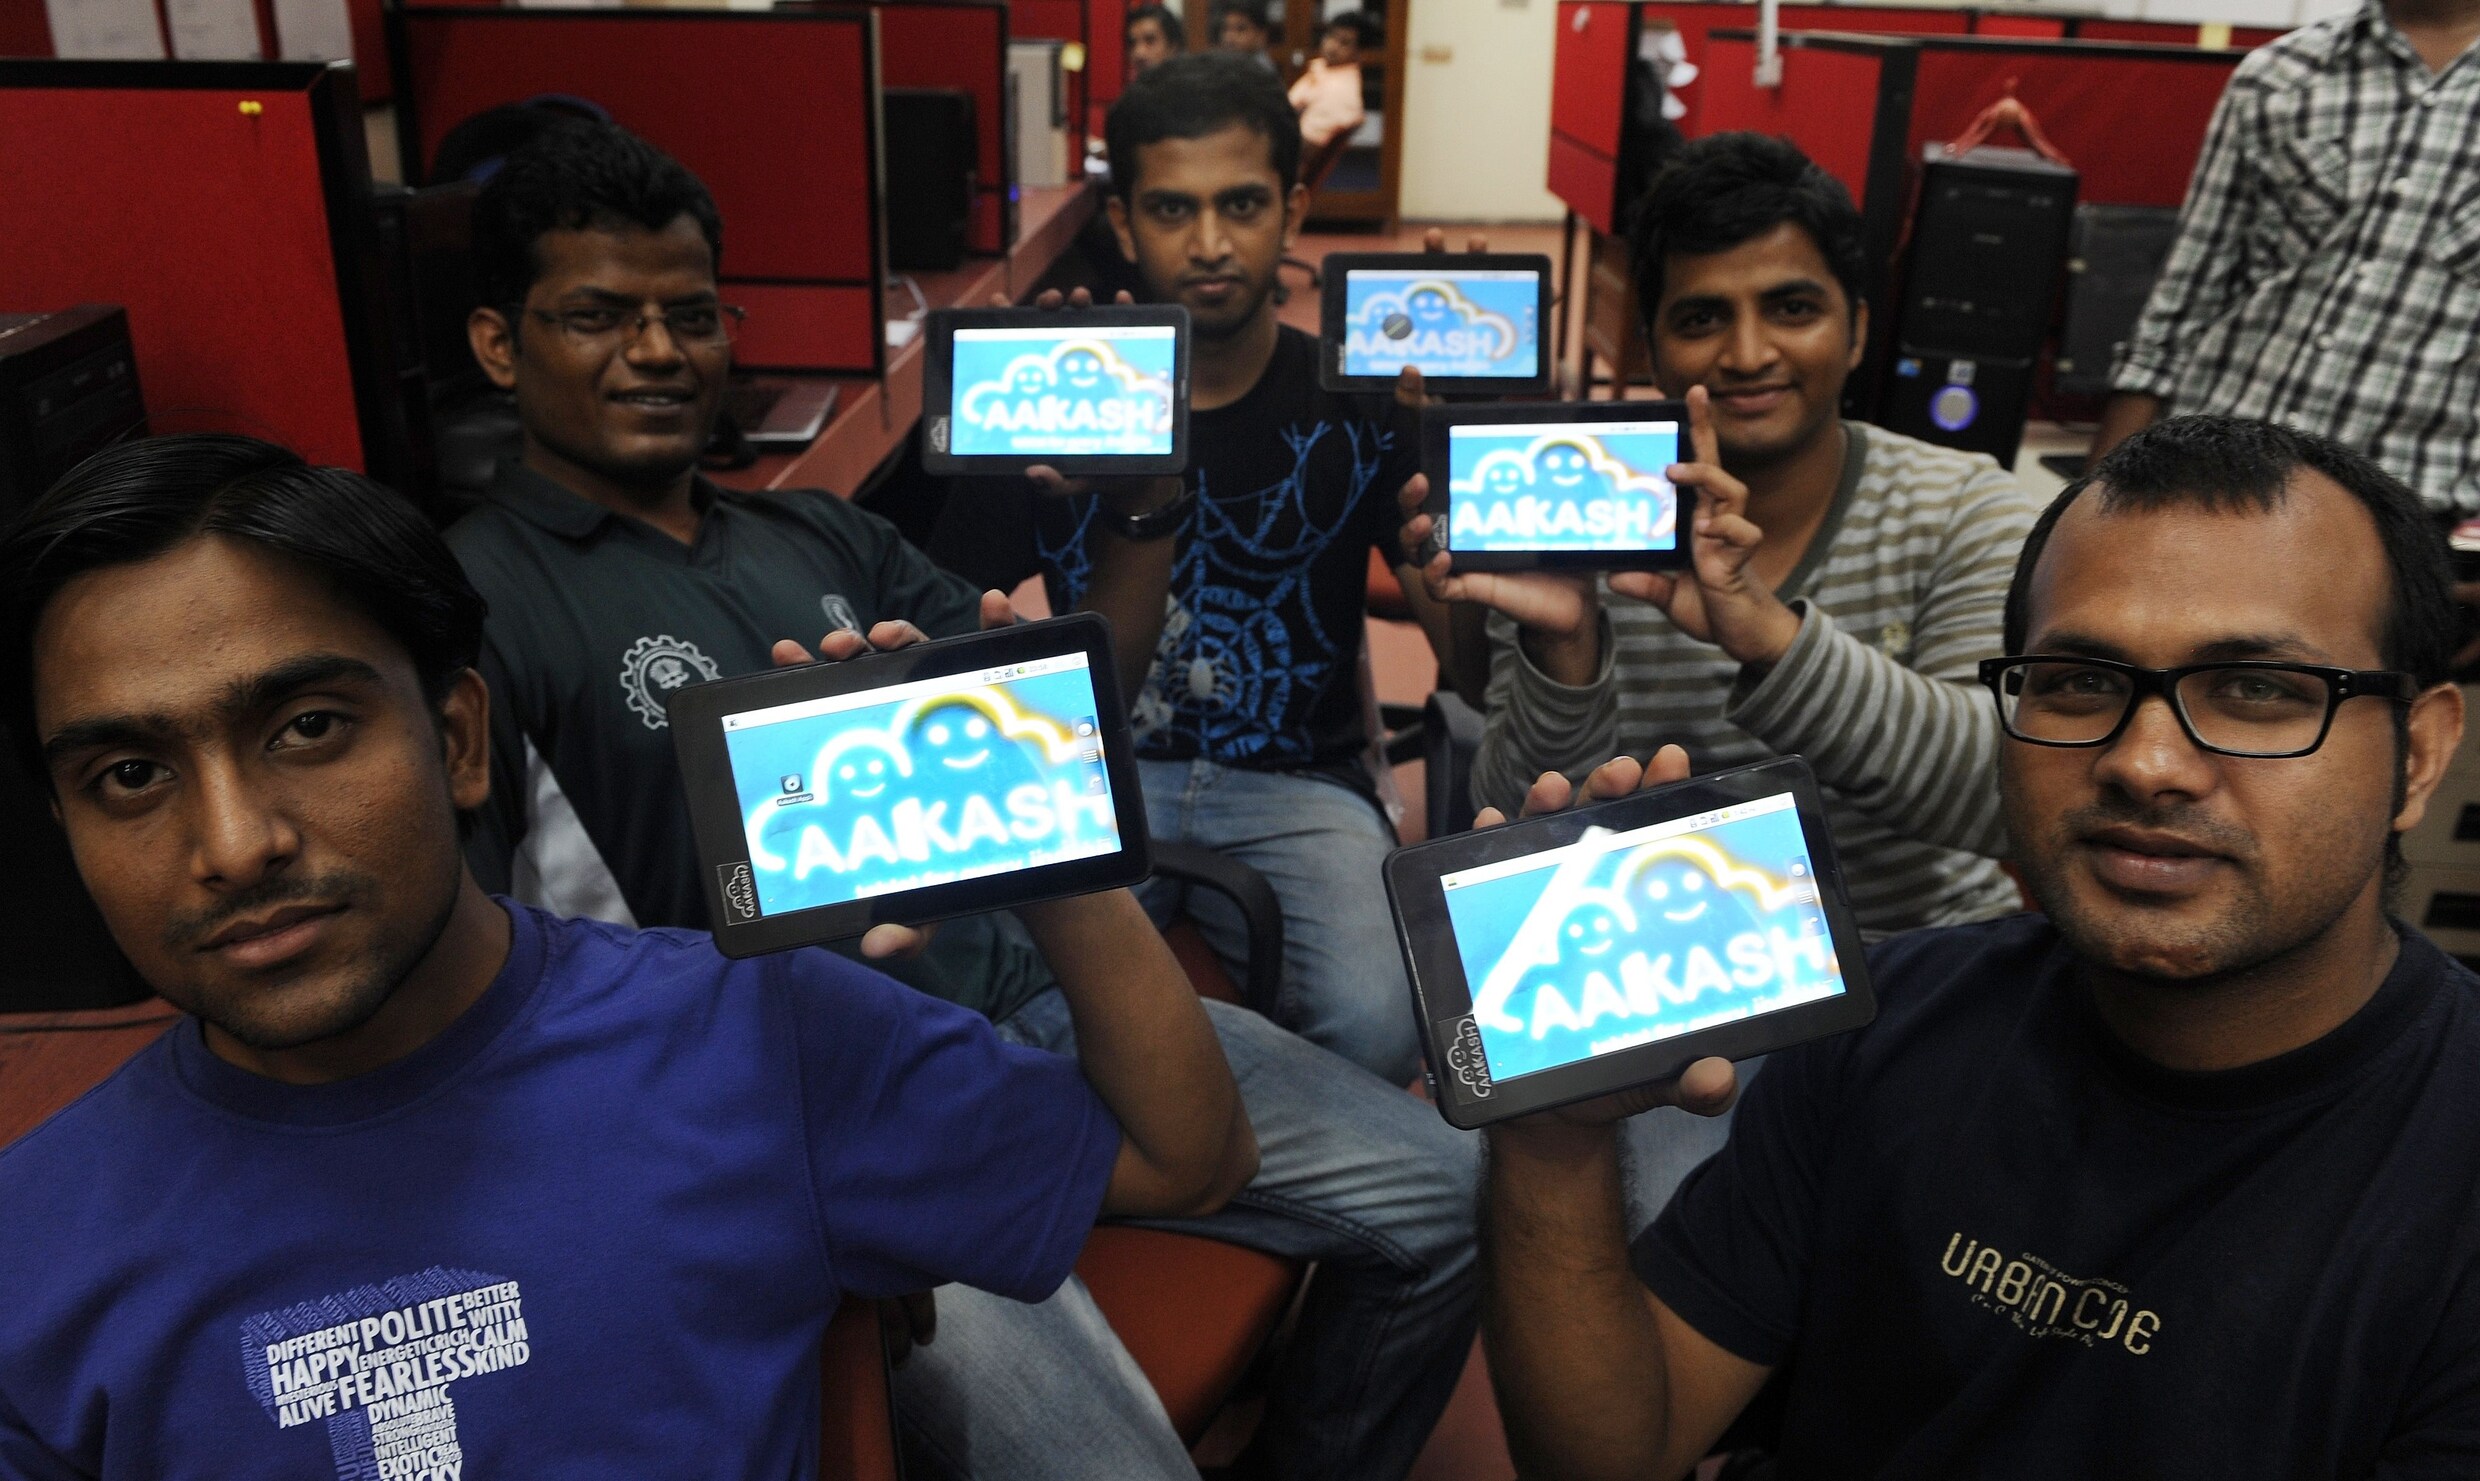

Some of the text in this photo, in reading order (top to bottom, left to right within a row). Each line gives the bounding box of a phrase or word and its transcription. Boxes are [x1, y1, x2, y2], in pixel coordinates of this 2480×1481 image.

[983, 396, 1155, 432] AAKASH
[1452, 497, 1649, 536] AAKASH
[794, 778, 1110, 880] AAKASH
[1530, 927, 1826, 1040] AAKASH
[1464, 1026, 1492, 1087] AAKASH
[1941, 1232, 2067, 1325] URBAN
[266, 1281, 521, 1366] DIFFERENT POLITE BETTER
[467, 1299, 522, 1328] WITTY
[270, 1317, 528, 1396] HAPPY ENERGETIC RICH CALM
[338, 1345, 476, 1410] FEARLESS
[473, 1341, 531, 1376] KIND
[279, 1391, 337, 1429] ALIVE
[367, 1384, 453, 1425] DYNAMIC
[416, 1403, 456, 1426] BRAVE
[374, 1426, 457, 1460] INTELLIGENT
[377, 1447, 440, 1480] EXOTIC
